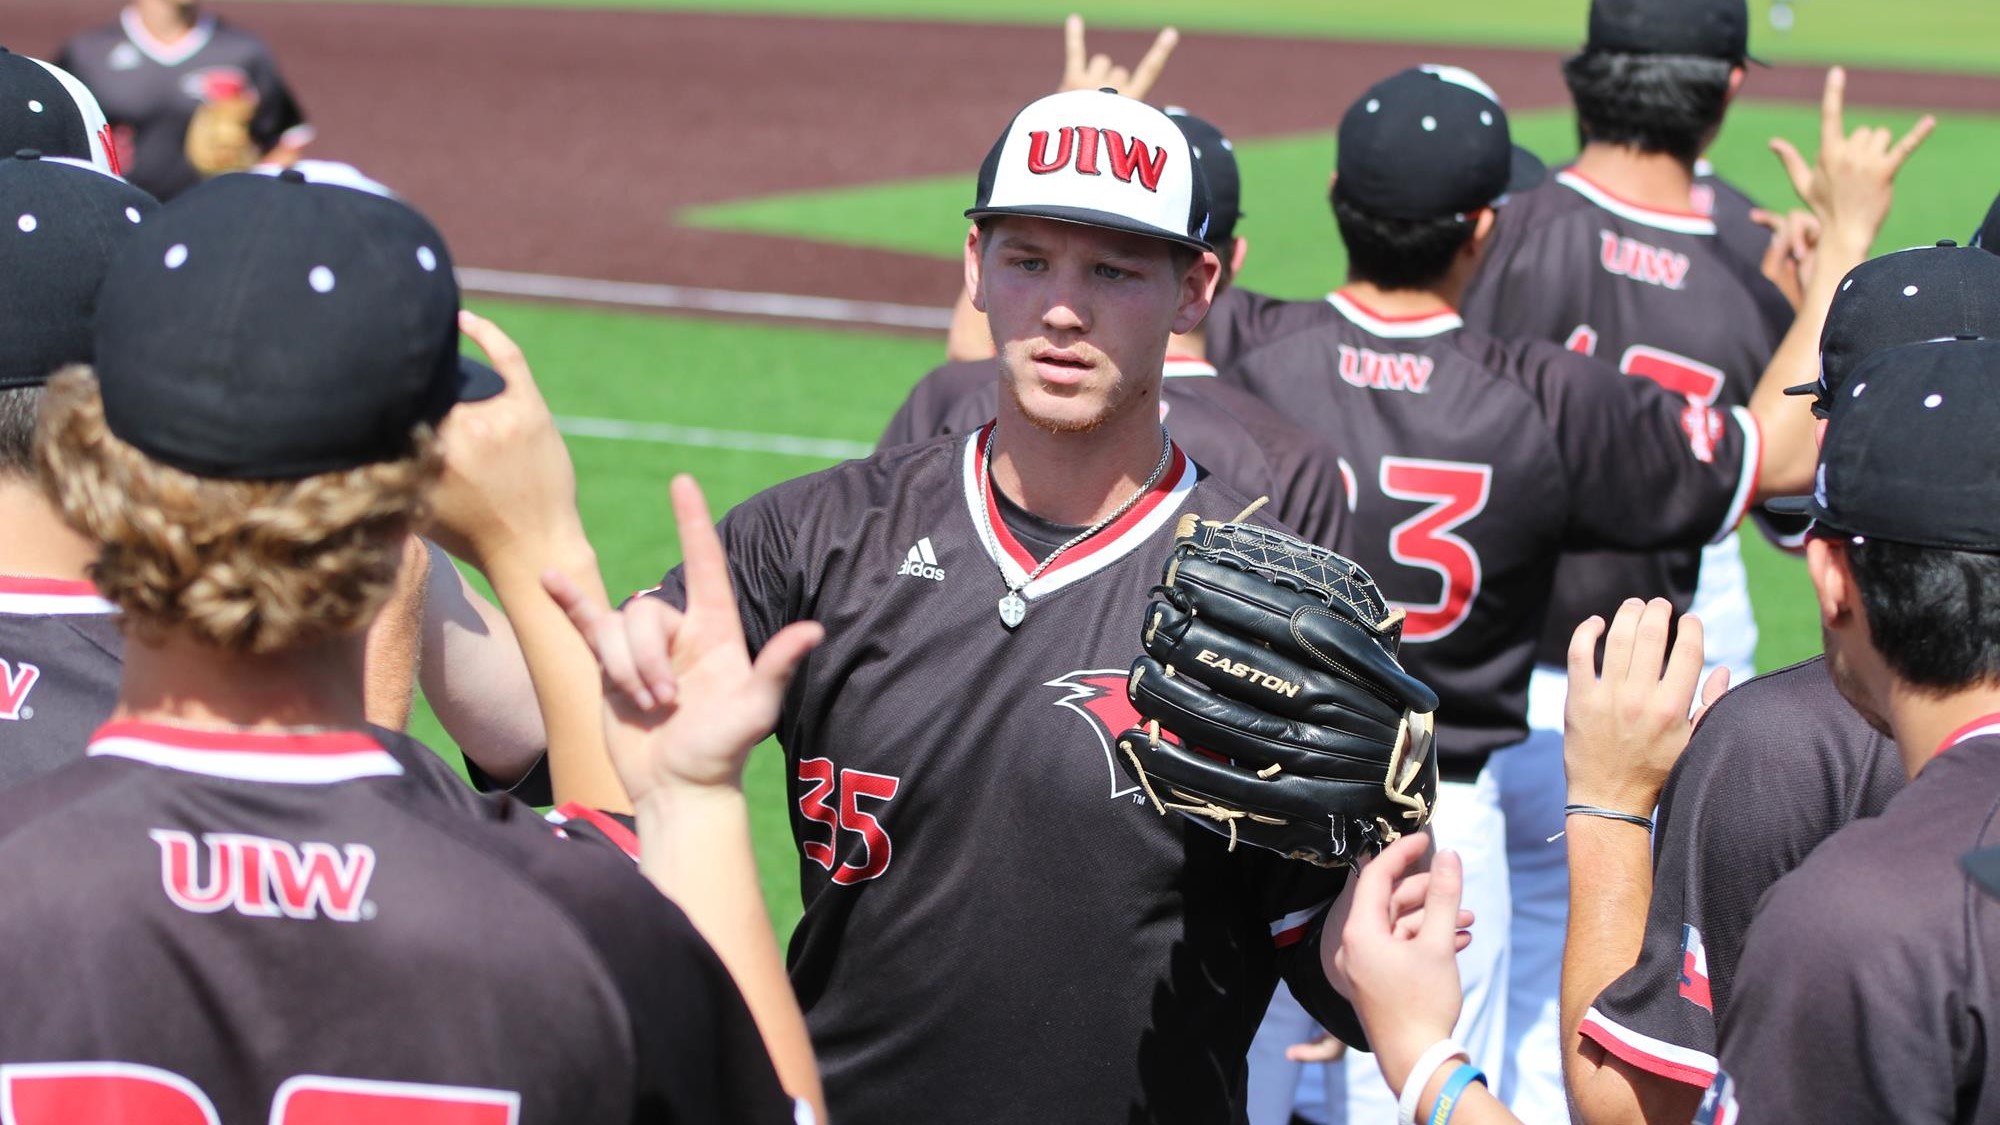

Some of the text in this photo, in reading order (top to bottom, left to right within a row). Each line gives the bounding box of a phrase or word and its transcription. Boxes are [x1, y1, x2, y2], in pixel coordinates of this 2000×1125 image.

[1028, 126, 1168, 193] UIW
[1600, 229, 1690, 290] UIW
[1338, 345, 1434, 393] UIW
[897, 559, 945, 581] didas
[1337, 456, 1493, 643] 3
[1195, 649, 1301, 698] EASTON
[798, 757, 900, 886] 35
[1132, 793, 1146, 806] TM
[148, 828, 376, 922] UIW
